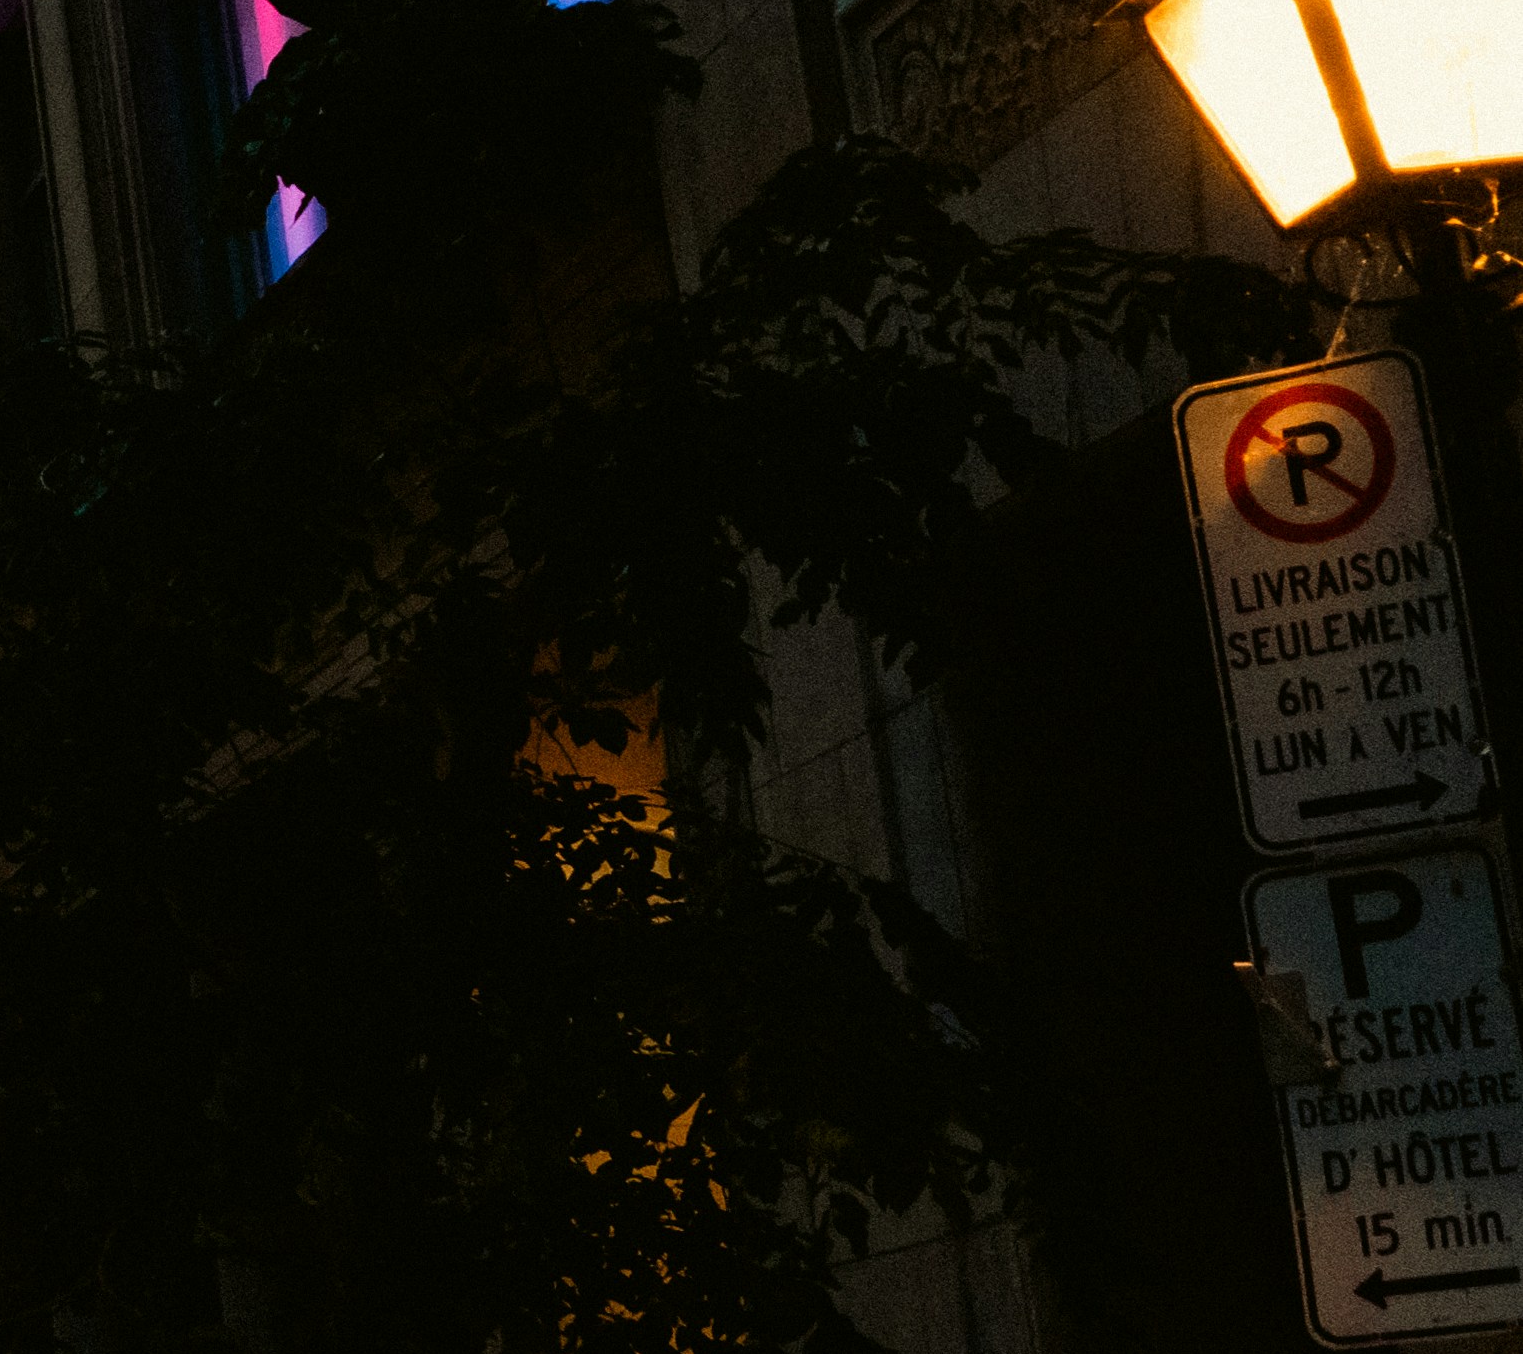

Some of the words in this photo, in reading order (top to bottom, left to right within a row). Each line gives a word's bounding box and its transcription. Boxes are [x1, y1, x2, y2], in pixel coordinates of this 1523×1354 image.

[1231, 541, 1429, 614] LIVRAISON
[1227, 595, 1451, 670] SEULEMENT
[1278, 677, 1325, 716] 6h
[1358, 658, 1422, 702] 12h
[1253, 728, 1328, 776] LUN
[1384, 704, 1463, 754] VEN
[1330, 868, 1423, 1000] P
[1308, 986, 1496, 1067] ÉSERVÉ
[1374, 1131, 1519, 1189] HÔTEL
[1356, 1212, 1399, 1258] 15
